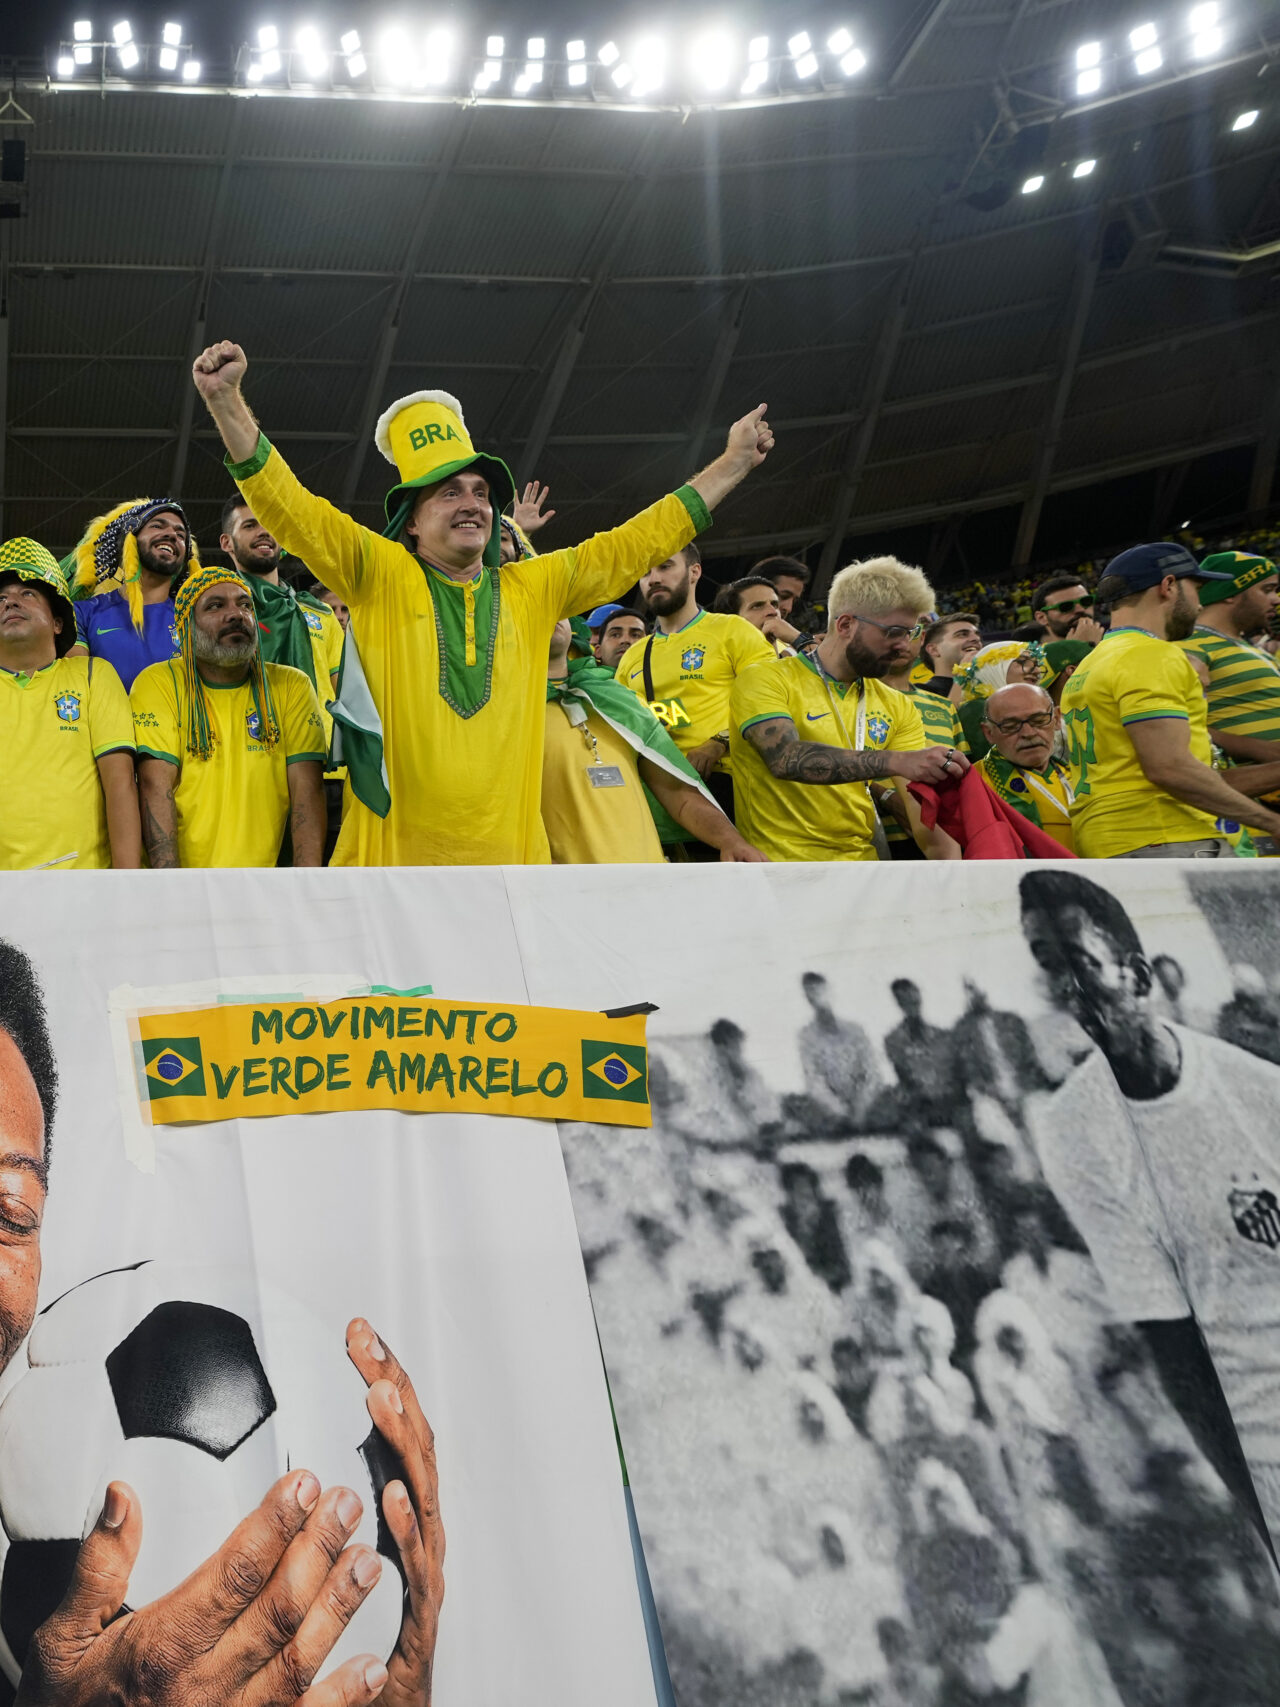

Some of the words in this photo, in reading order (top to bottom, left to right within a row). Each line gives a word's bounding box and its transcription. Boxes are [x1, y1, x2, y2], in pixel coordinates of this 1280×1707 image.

[409, 423, 462, 451] BRA
[649, 700, 691, 726] RA
[251, 1006, 518, 1045] MOVIMENTO
[211, 1053, 352, 1100] VERDE
[366, 1050, 569, 1099] AMARELO
